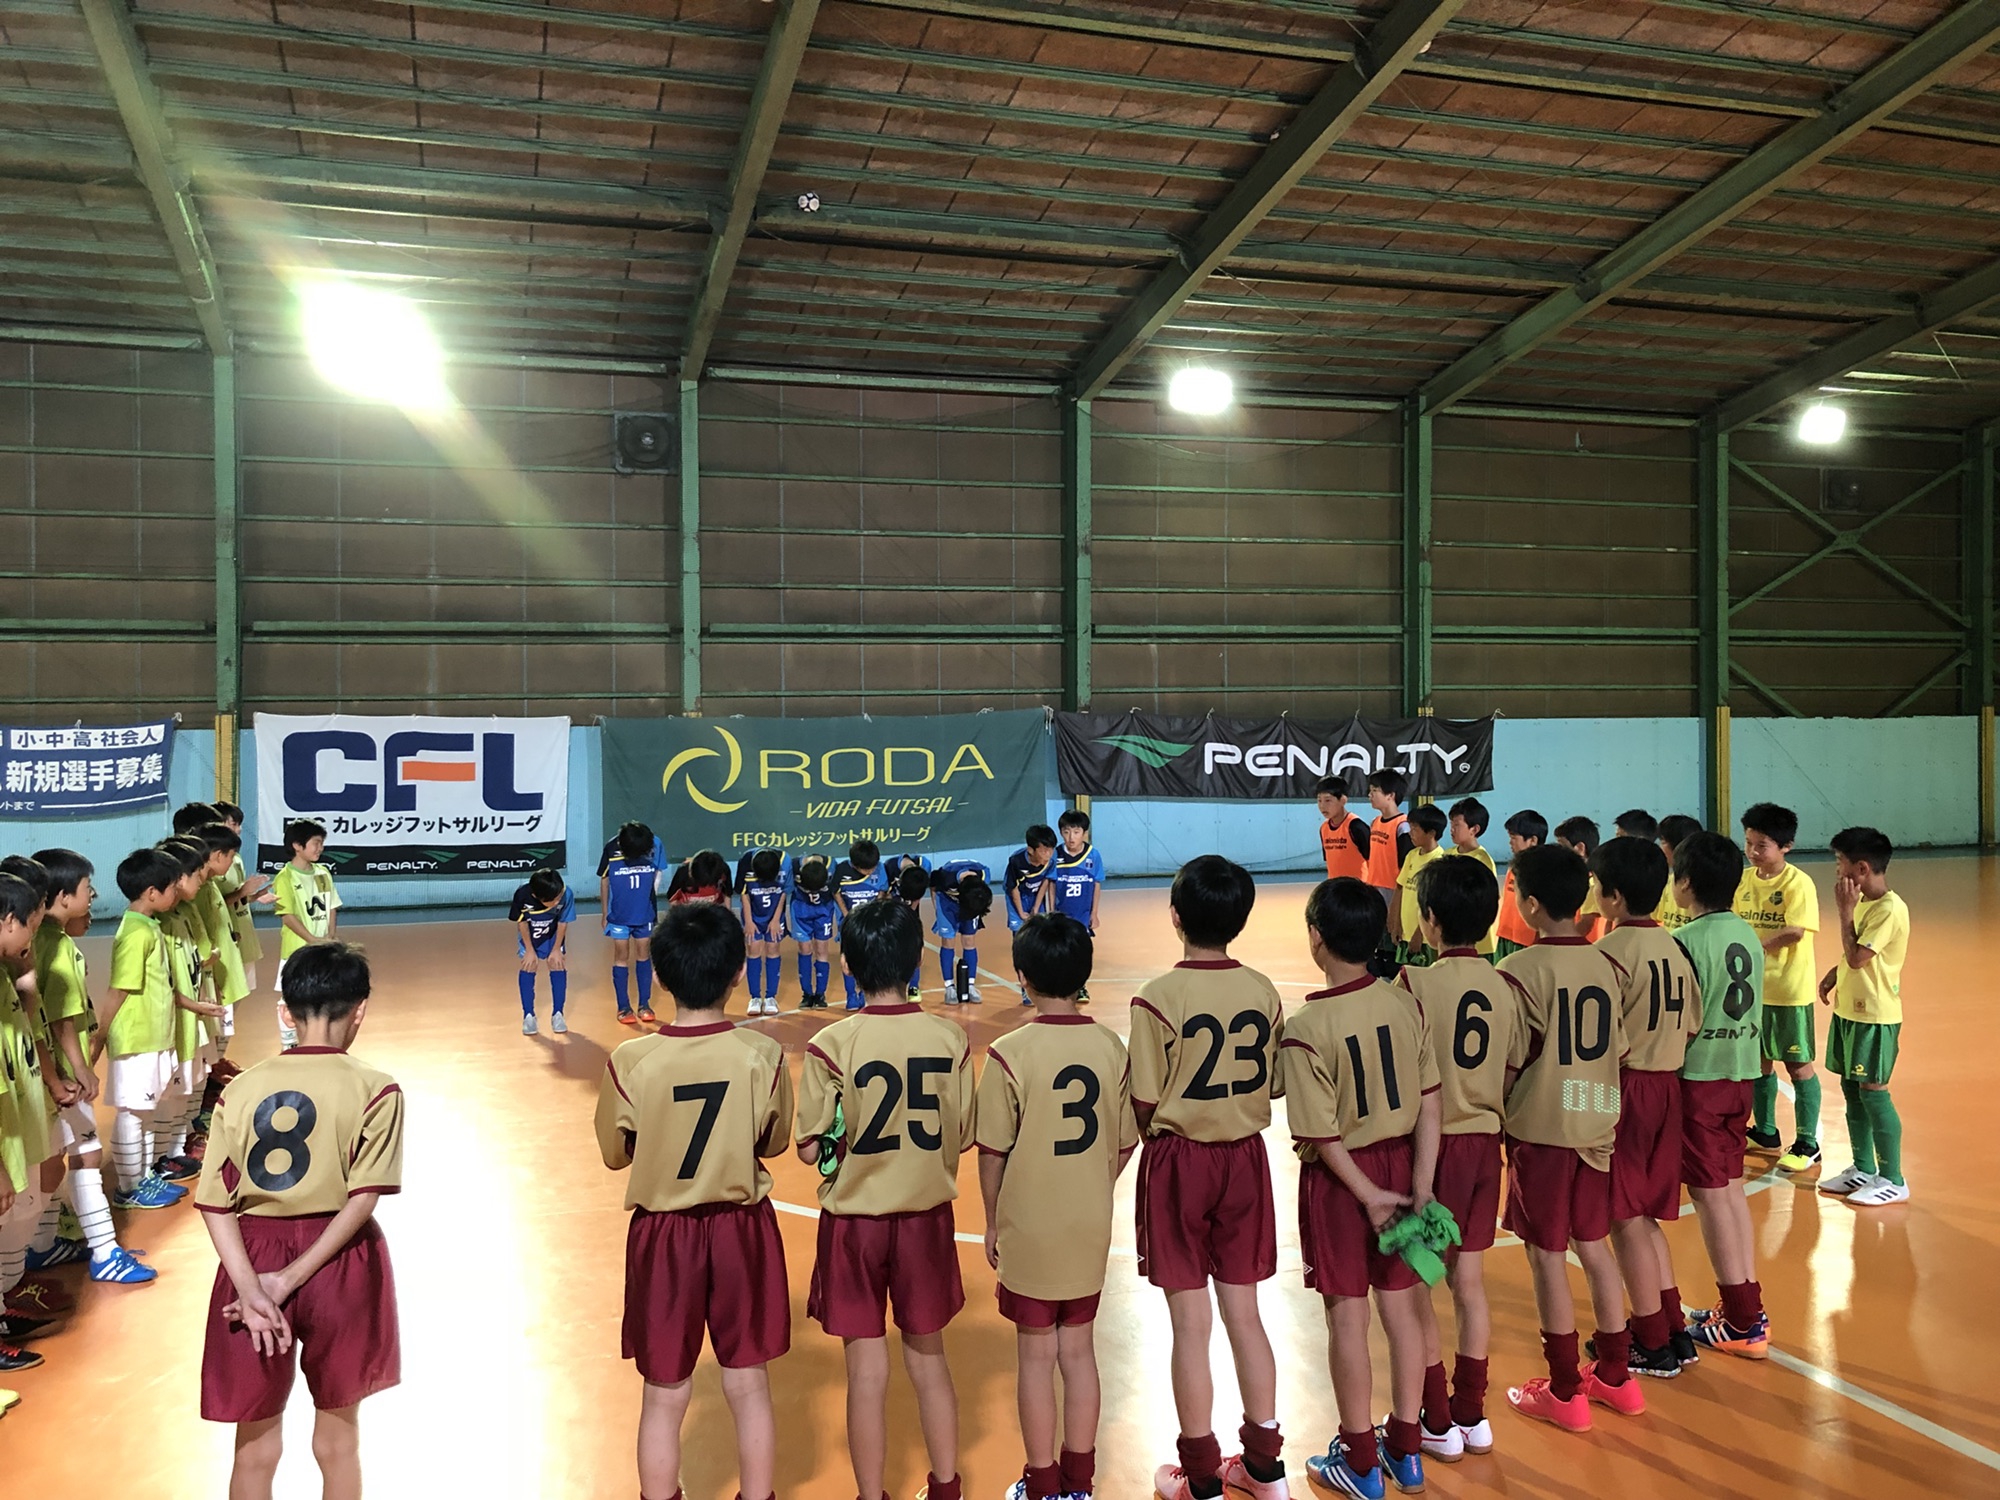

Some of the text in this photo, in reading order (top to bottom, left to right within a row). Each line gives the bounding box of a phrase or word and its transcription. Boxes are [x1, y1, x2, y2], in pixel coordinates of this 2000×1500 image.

[5, 753, 163, 793] 新規選手募集
[282, 730, 544, 812] CFL
[759, 743, 995, 789] RODA
[1203, 742, 1468, 777] PENALTY
[806, 796, 955, 819] VIDA FUTSAL
[366, 861, 437, 871] PENALTY
[467, 859, 535, 869] PENALTY
[630, 874, 640, 889] 11
[762, 895, 771, 908] 5
[1066, 883, 1082, 897] 28
[1647, 958, 1684, 1032] 14
[1722, 942, 1755, 1022] 8
[1180, 1009, 1271, 1101] 23
[1453, 990, 1493, 1070] 6
[1557, 985, 1612, 1066] 10
[851, 1056, 954, 1155] 25
[1052, 1064, 1100, 1156] 3
[1345, 1024, 1402, 1119] 11
[247, 1090, 318, 1192] 8
[673, 1080, 730, 1180] 7
